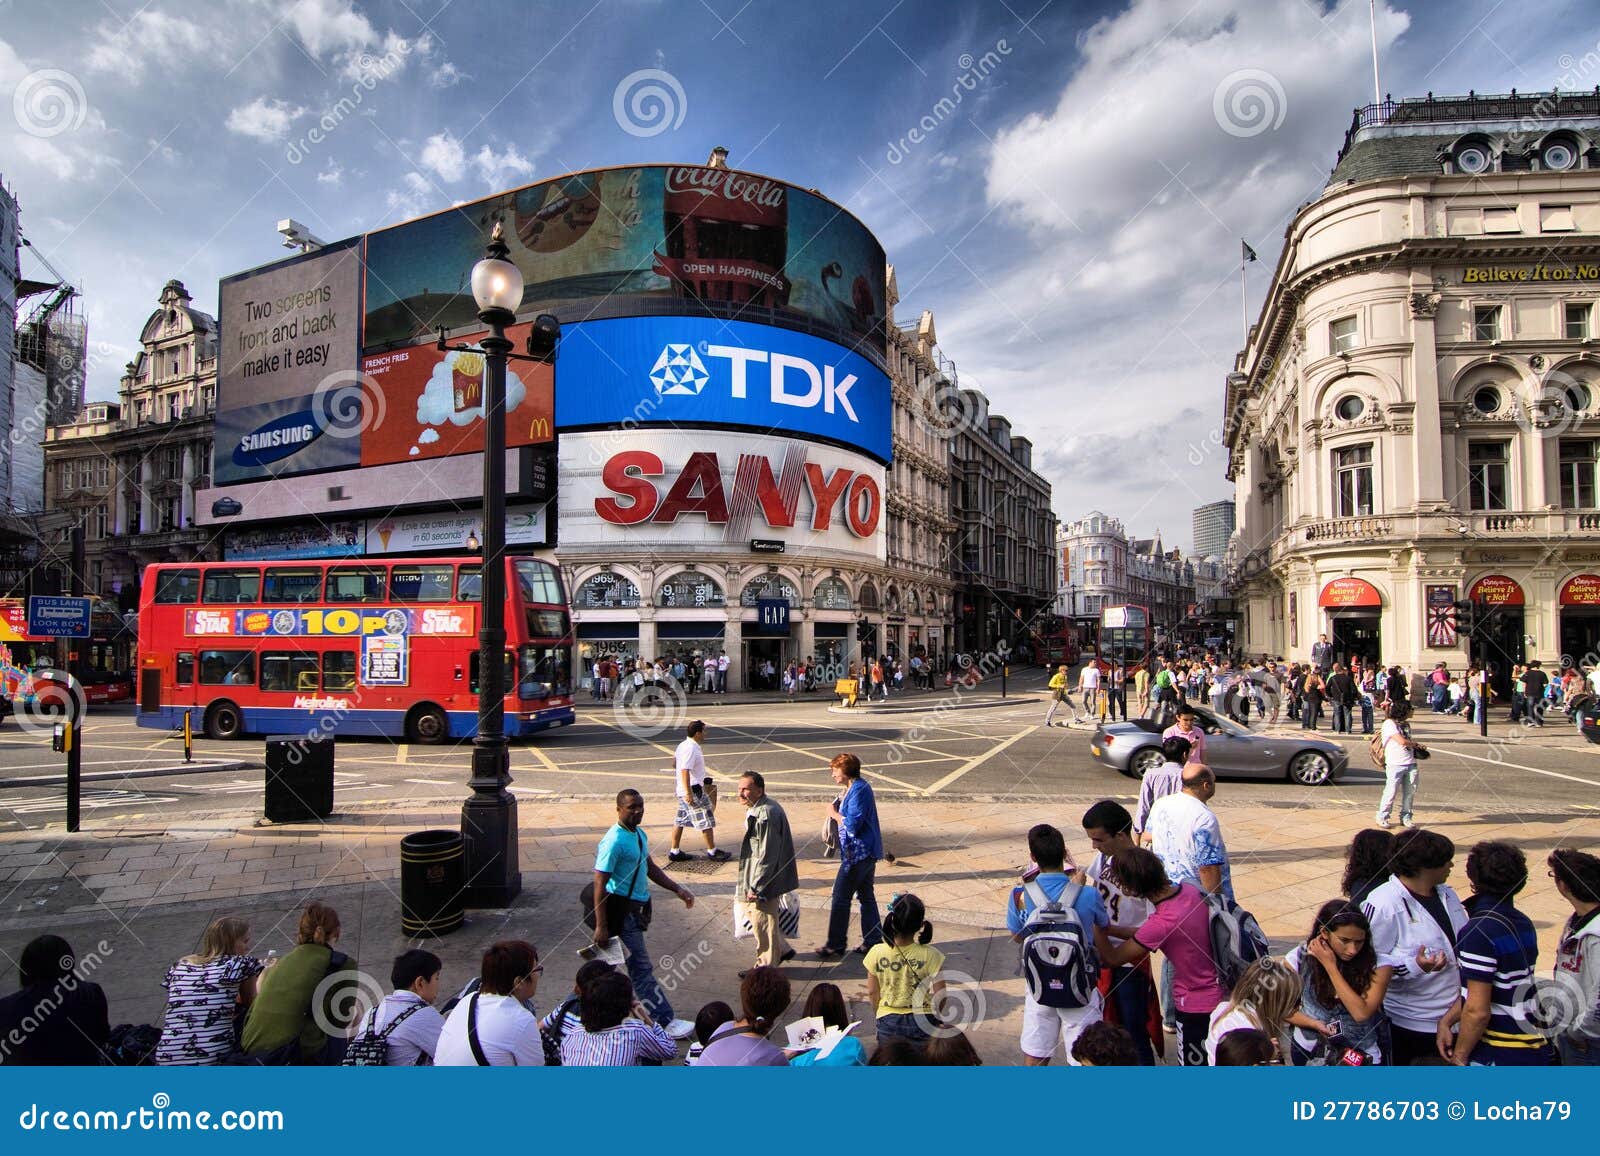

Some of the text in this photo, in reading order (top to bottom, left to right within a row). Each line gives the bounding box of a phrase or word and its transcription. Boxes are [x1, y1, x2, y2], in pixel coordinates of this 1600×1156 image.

[682, 264, 785, 290] OPEN HAPPINESS
[1463, 266, 1528, 282] Believe
[1533, 264, 1549, 280] It
[1553, 267, 1573, 280] or
[245, 285, 331, 322] Two screens
[240, 308, 337, 352] front and back
[243, 343, 331, 378] make it easy
[365, 352, 409, 369] FRENCH FRIES
[707, 344, 860, 423] TDK
[241, 424, 314, 452] SAMSUNG
[594, 441, 881, 542] SANYO
[1329, 587, 1356, 595] Believe
[194, 610, 230, 635] STAR
[421, 609, 463, 634] STAR
[764, 607, 785, 624] GAP
[294, 695, 348, 709] Metroline
[1344, 1049, 1362, 1064] A&F
